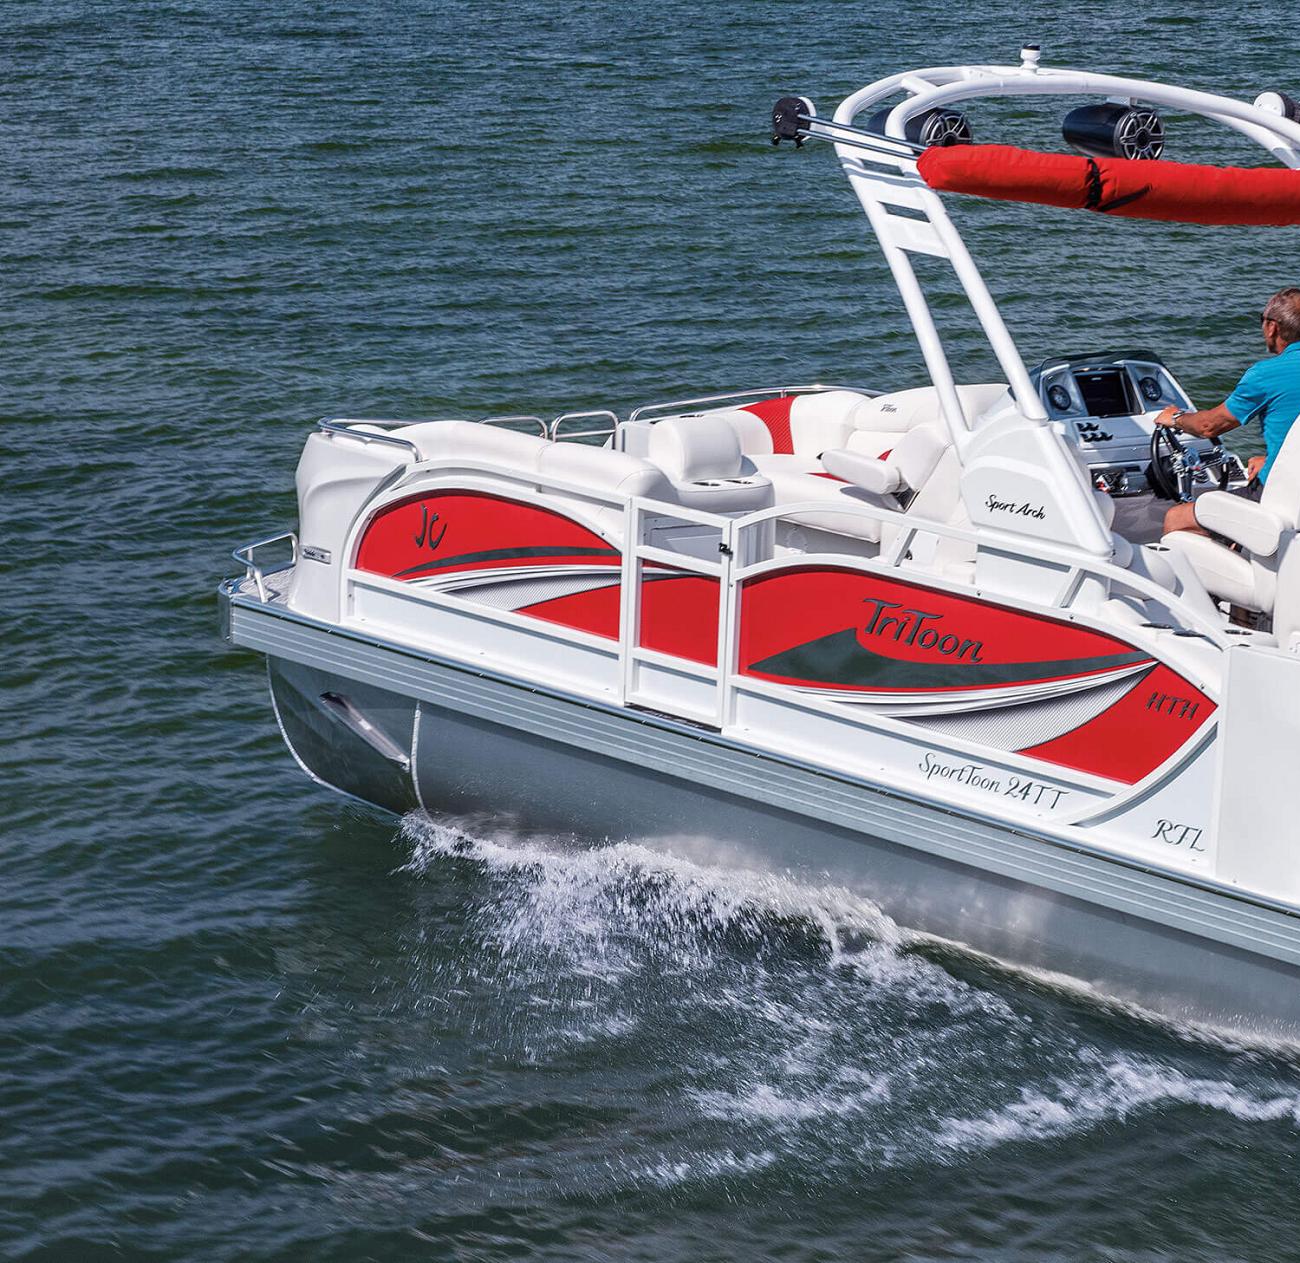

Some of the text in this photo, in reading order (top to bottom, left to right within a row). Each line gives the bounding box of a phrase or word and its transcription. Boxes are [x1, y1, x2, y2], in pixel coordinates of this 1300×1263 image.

[985, 494, 1046, 520] Sport Arch
[863, 598, 983, 663] TriToon
[1146, 691, 1199, 720] HTH
[1151, 819, 1206, 852] RTL
